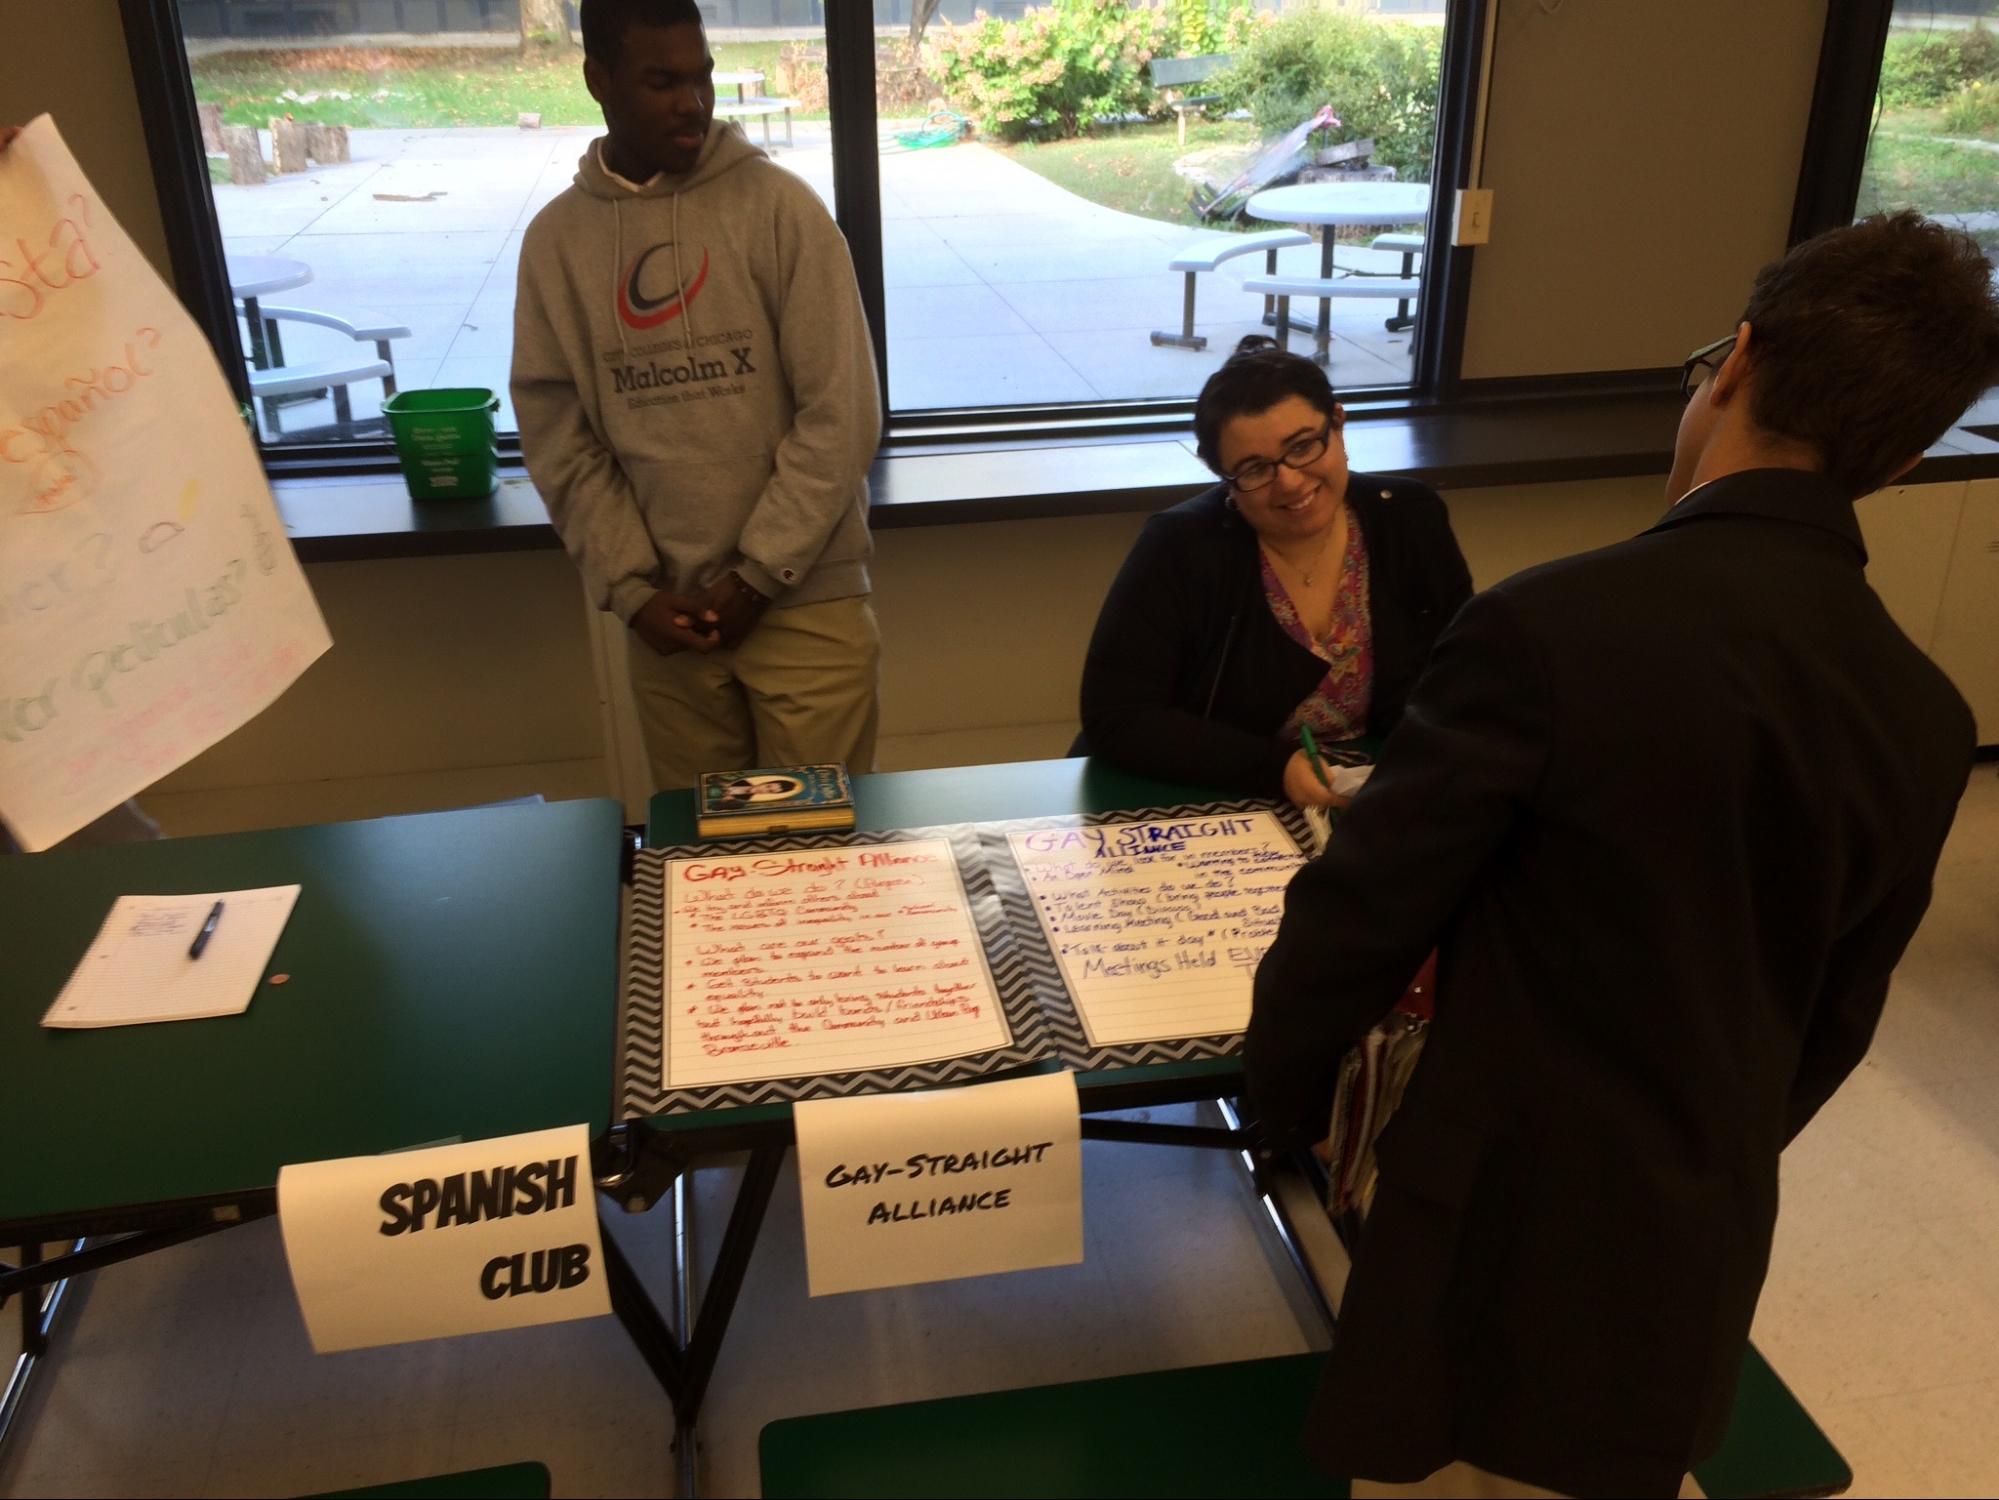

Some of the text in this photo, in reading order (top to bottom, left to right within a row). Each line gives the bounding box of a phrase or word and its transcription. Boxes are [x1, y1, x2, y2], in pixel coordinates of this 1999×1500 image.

[610, 346, 756, 393] Malcolm X
[1025, 819, 1254, 852] GAY STRAIGHT
[1094, 840, 1185, 858] ALLIANCE
[1175, 950, 1216, 970] Held
[824, 1141, 1054, 1188] GAY-STRAIGHT
[378, 1155, 579, 1237] SPANISH
[866, 1188, 1012, 1226] ALLIANCE
[479, 1243, 592, 1300] CLUB
